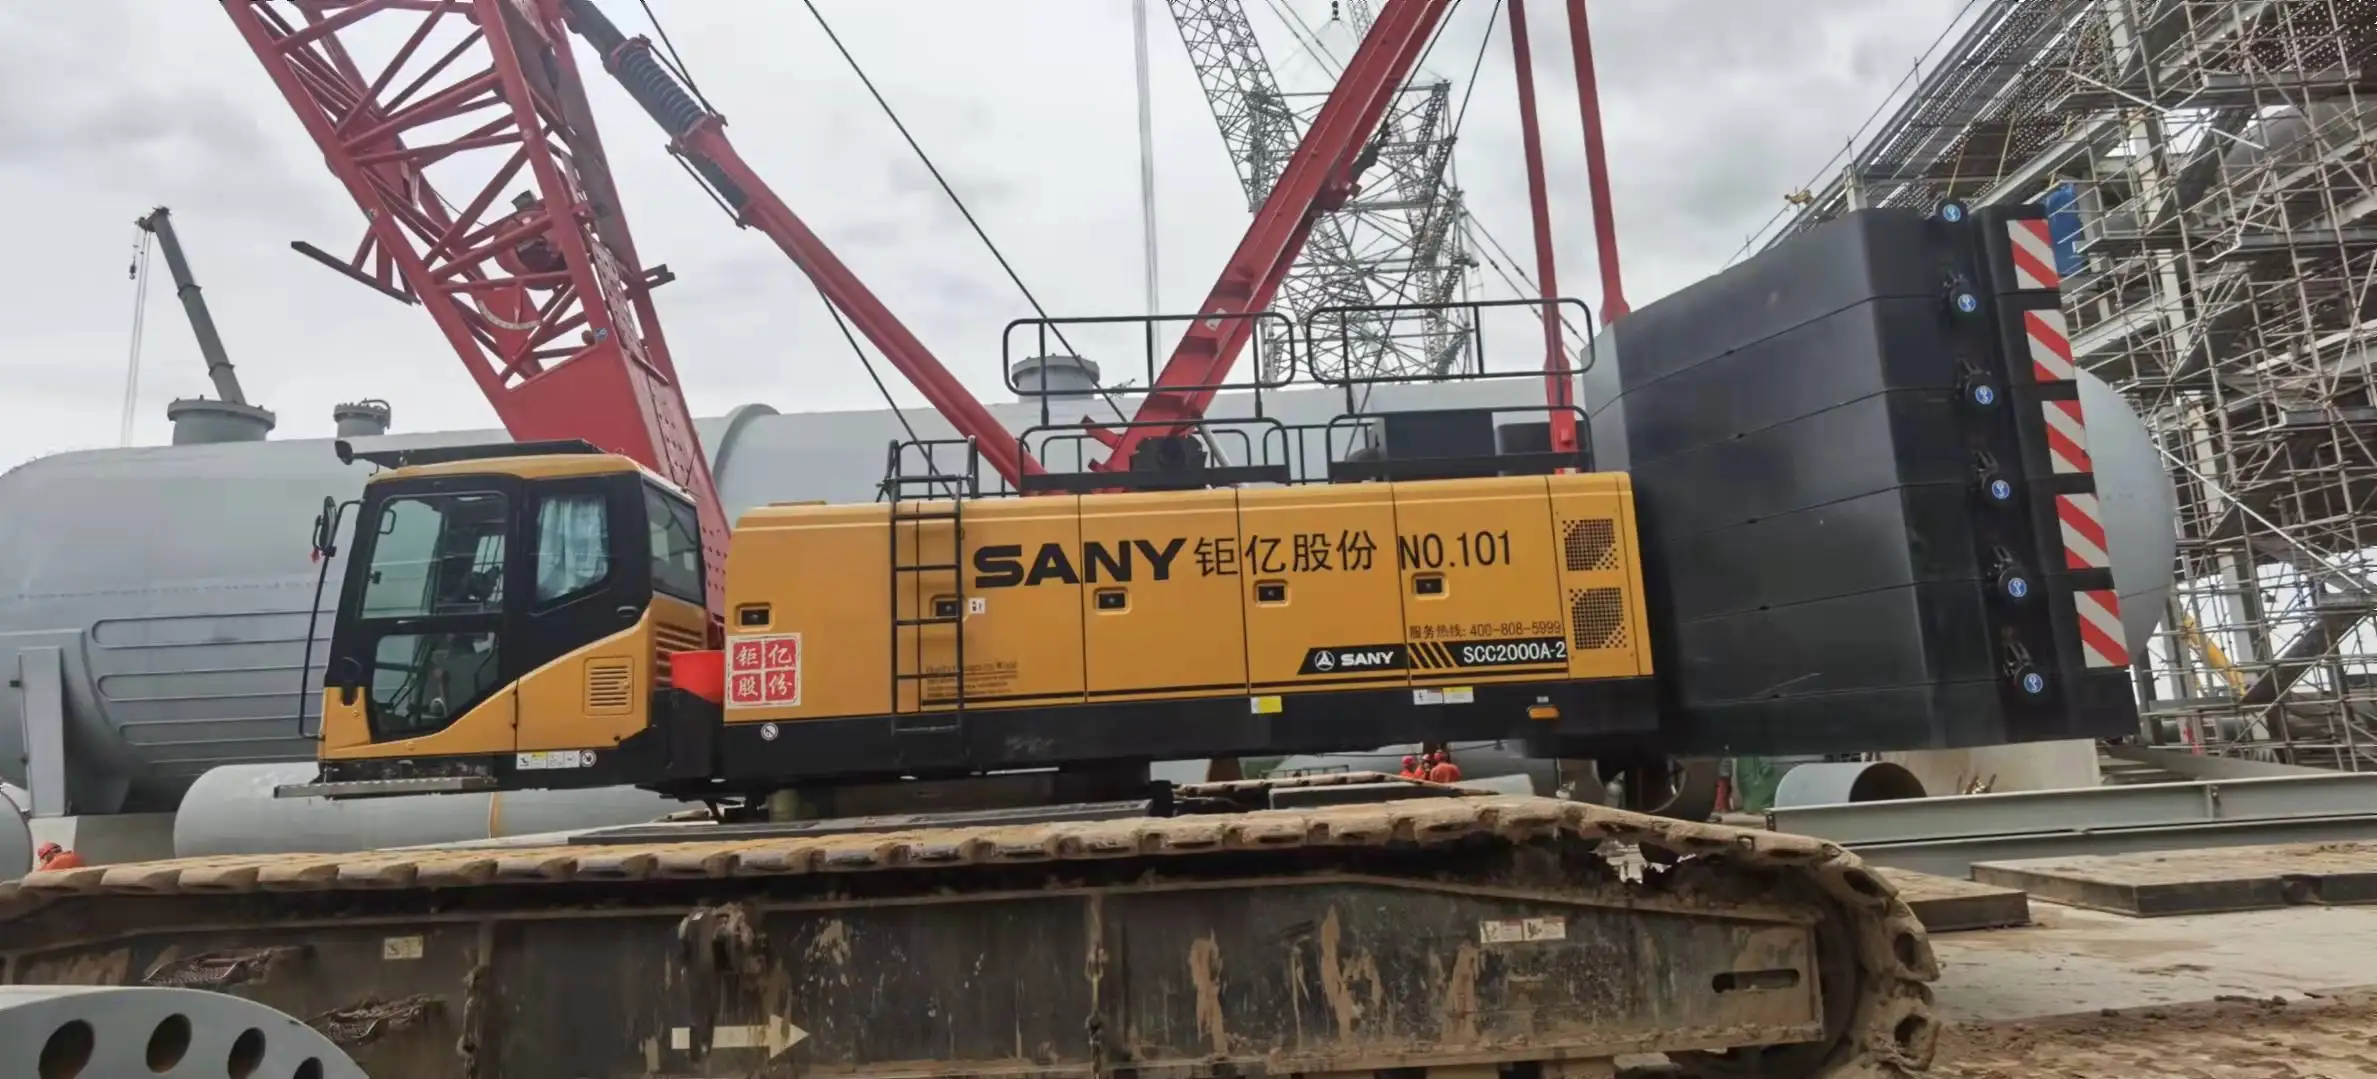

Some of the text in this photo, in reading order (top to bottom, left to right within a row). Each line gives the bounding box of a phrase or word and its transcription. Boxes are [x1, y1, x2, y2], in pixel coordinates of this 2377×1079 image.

[973, 538, 1187, 588] SANY
[1193, 529, 1511, 577] 钜亿股份 NO.101
[1340, 651, 1394, 666] SANY
[1463, 641, 1566, 663] SCC2000A-2
